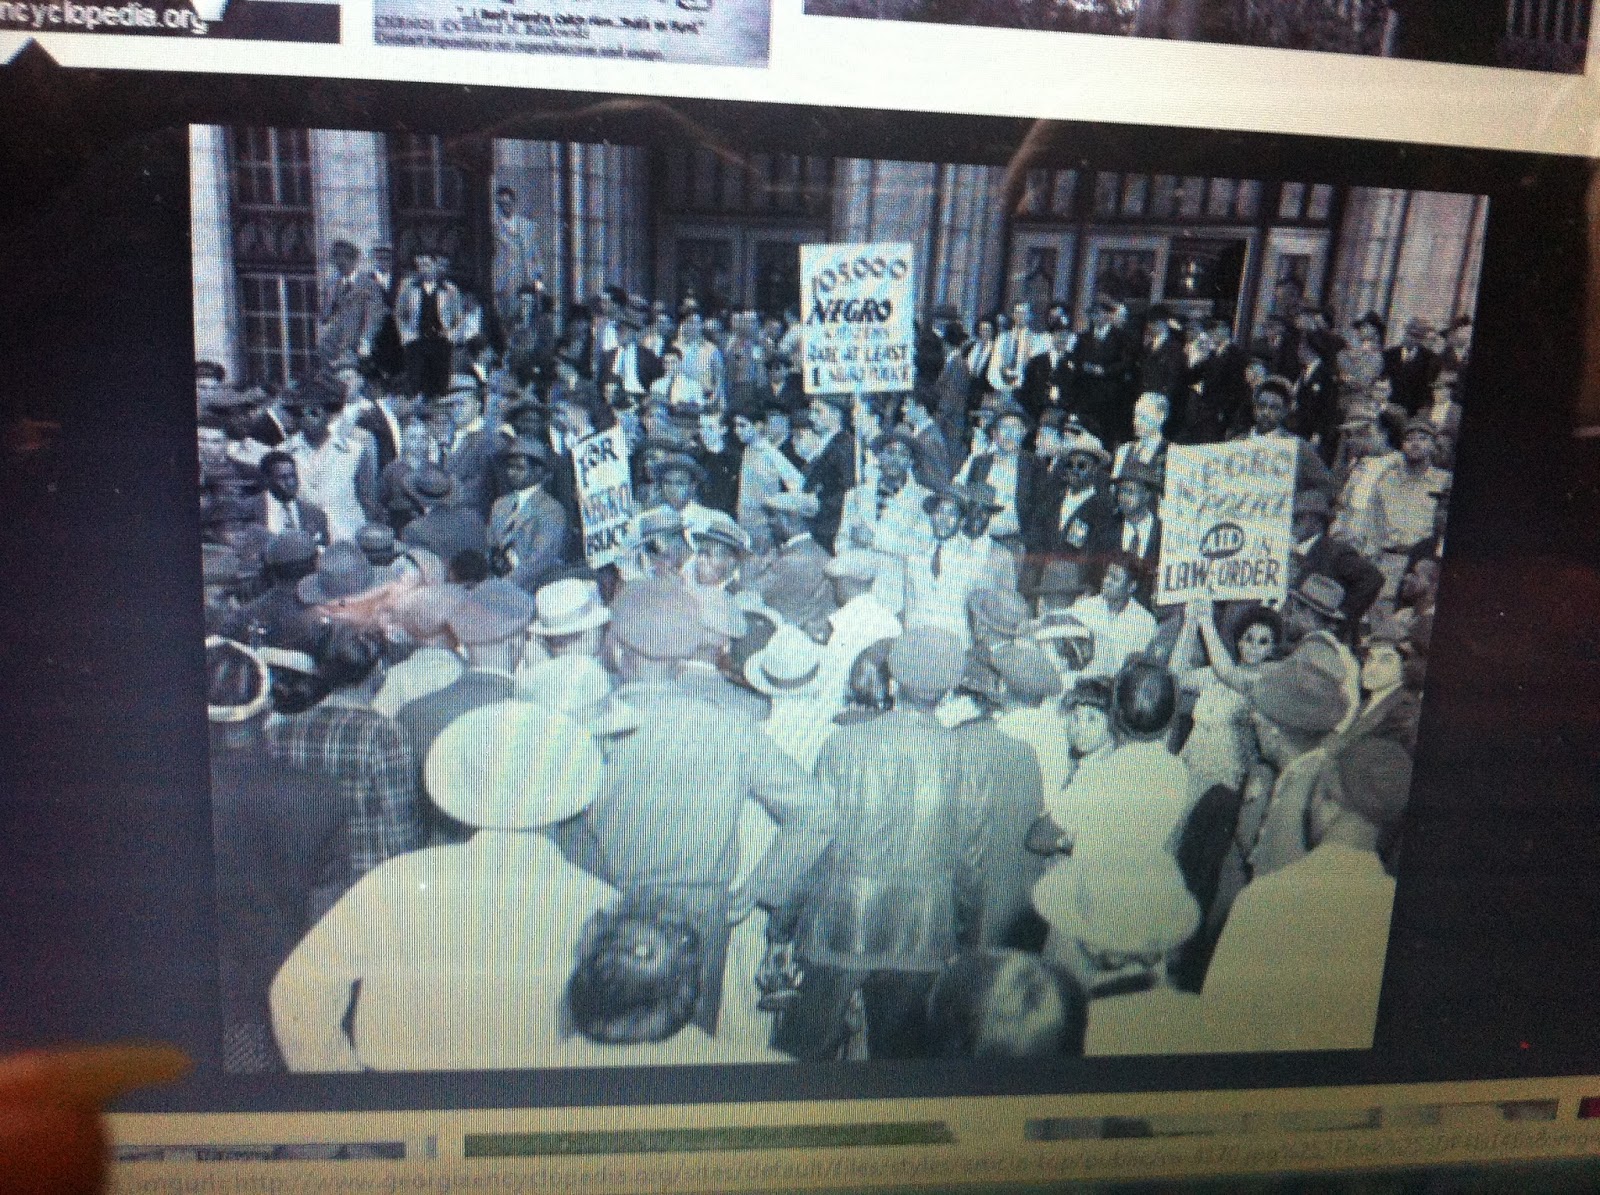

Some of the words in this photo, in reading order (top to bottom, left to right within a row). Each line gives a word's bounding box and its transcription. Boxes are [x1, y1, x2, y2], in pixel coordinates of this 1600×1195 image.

[805, 297, 894, 326] NEGRO
[1164, 560, 1209, 591] LAW
[1217, 558, 1280, 588] ORDER
